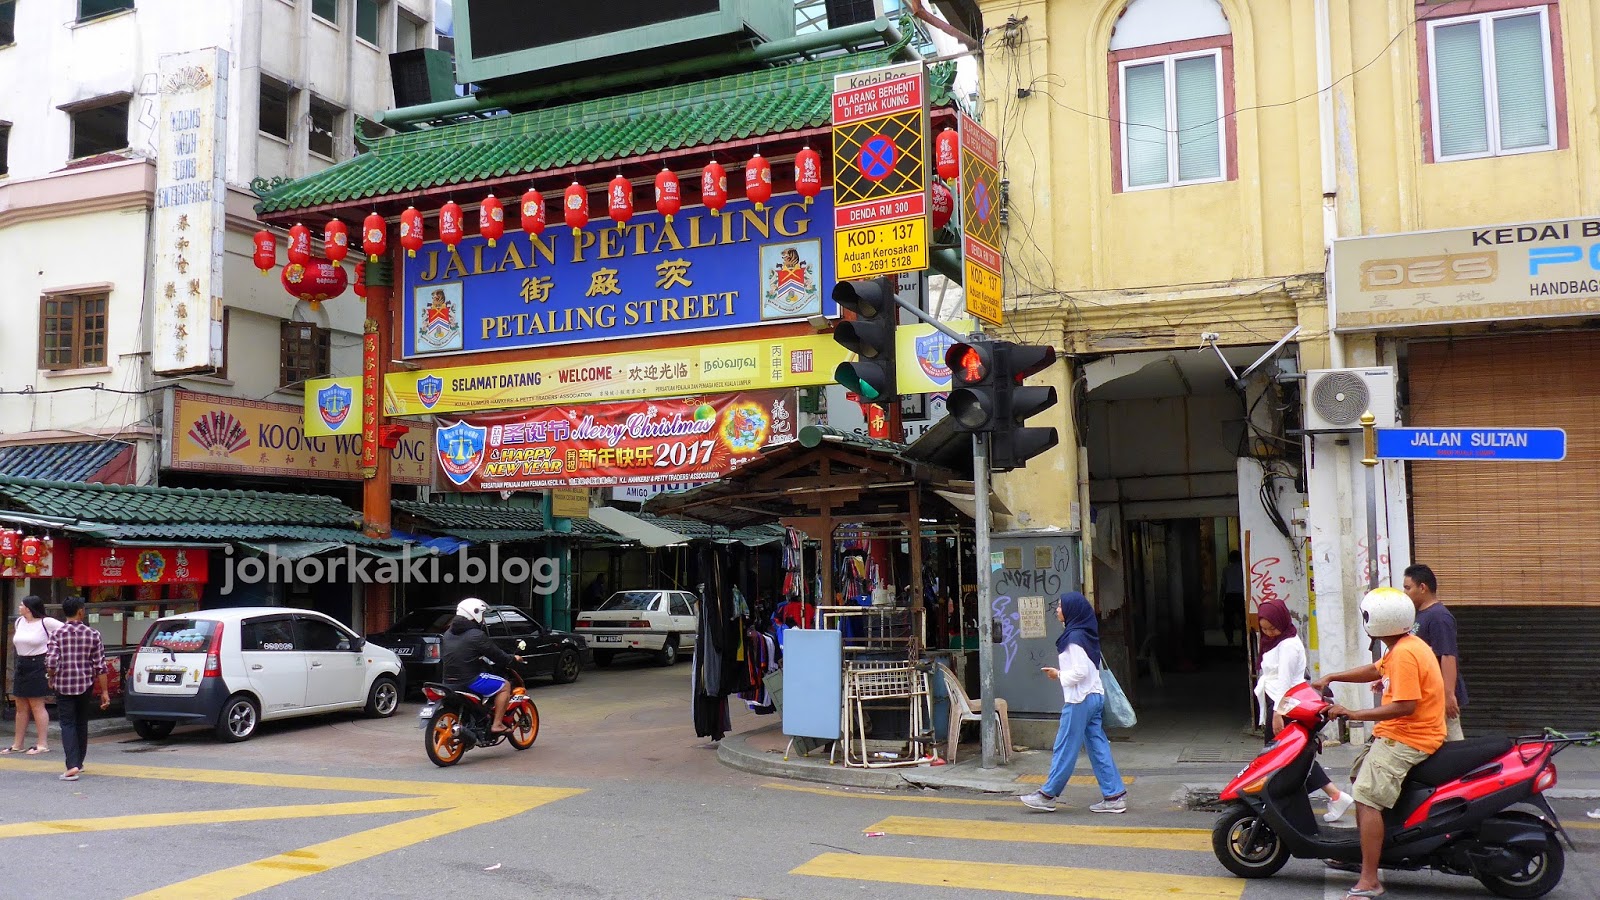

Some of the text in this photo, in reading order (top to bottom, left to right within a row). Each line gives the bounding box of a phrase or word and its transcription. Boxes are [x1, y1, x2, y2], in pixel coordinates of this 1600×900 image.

[838, 80, 915, 108] DILARANG BERHENTI
[844, 94, 909, 118] DI PETAK KUNING
[850, 202, 909, 222] DENDA RM 300
[421, 235, 559, 282] JALAN
[571, 202, 811, 263] PETALING
[848, 229, 876, 248] KOD
[892, 223, 914, 241] 137
[1472, 223, 1570, 247] KEDAI
[844, 244, 919, 263] Aduan Kerosakan
[852, 263, 863, 273] 03
[869, 259, 891, 271] 2691
[892, 257, 912, 268] 5128
[970, 266, 983, 285] KOD
[988, 276, 998, 292] 137
[1530, 280, 1600, 297] HANDBAG
[480, 303, 616, 340] PETALING
[624, 290, 740, 327] STREET
[1411, 306, 1481, 323] JALAN
[628, 361, 689, 382] 欢迎光临
[703, 356, 757, 373] நல்வரவு
[772, 345, 783, 381] 丙申年
[452, 365, 613, 392] SELAMAT DATANG WELCOME
[559, 392, 592, 400] ASSOCIATION
[503, 420, 571, 444] 圣诞节
[572, 412, 715, 446] Merry Christmas
[1411, 433, 1528, 447] JALAN SULTAN
[259, 424, 426, 462] KOONG WO ONG
[653, 439, 717, 468] 2017
[491, 446, 557, 463] & HAPPY
[578, 446, 654, 469] 新年快乐
[484, 462, 523, 477] NEW
[523, 460, 563, 476] YEAR
[690, 471, 719, 480] ASSOCIATION
[481, 481, 504, 489] PERSATUAN
[626, 487, 648, 498] AMIGO
